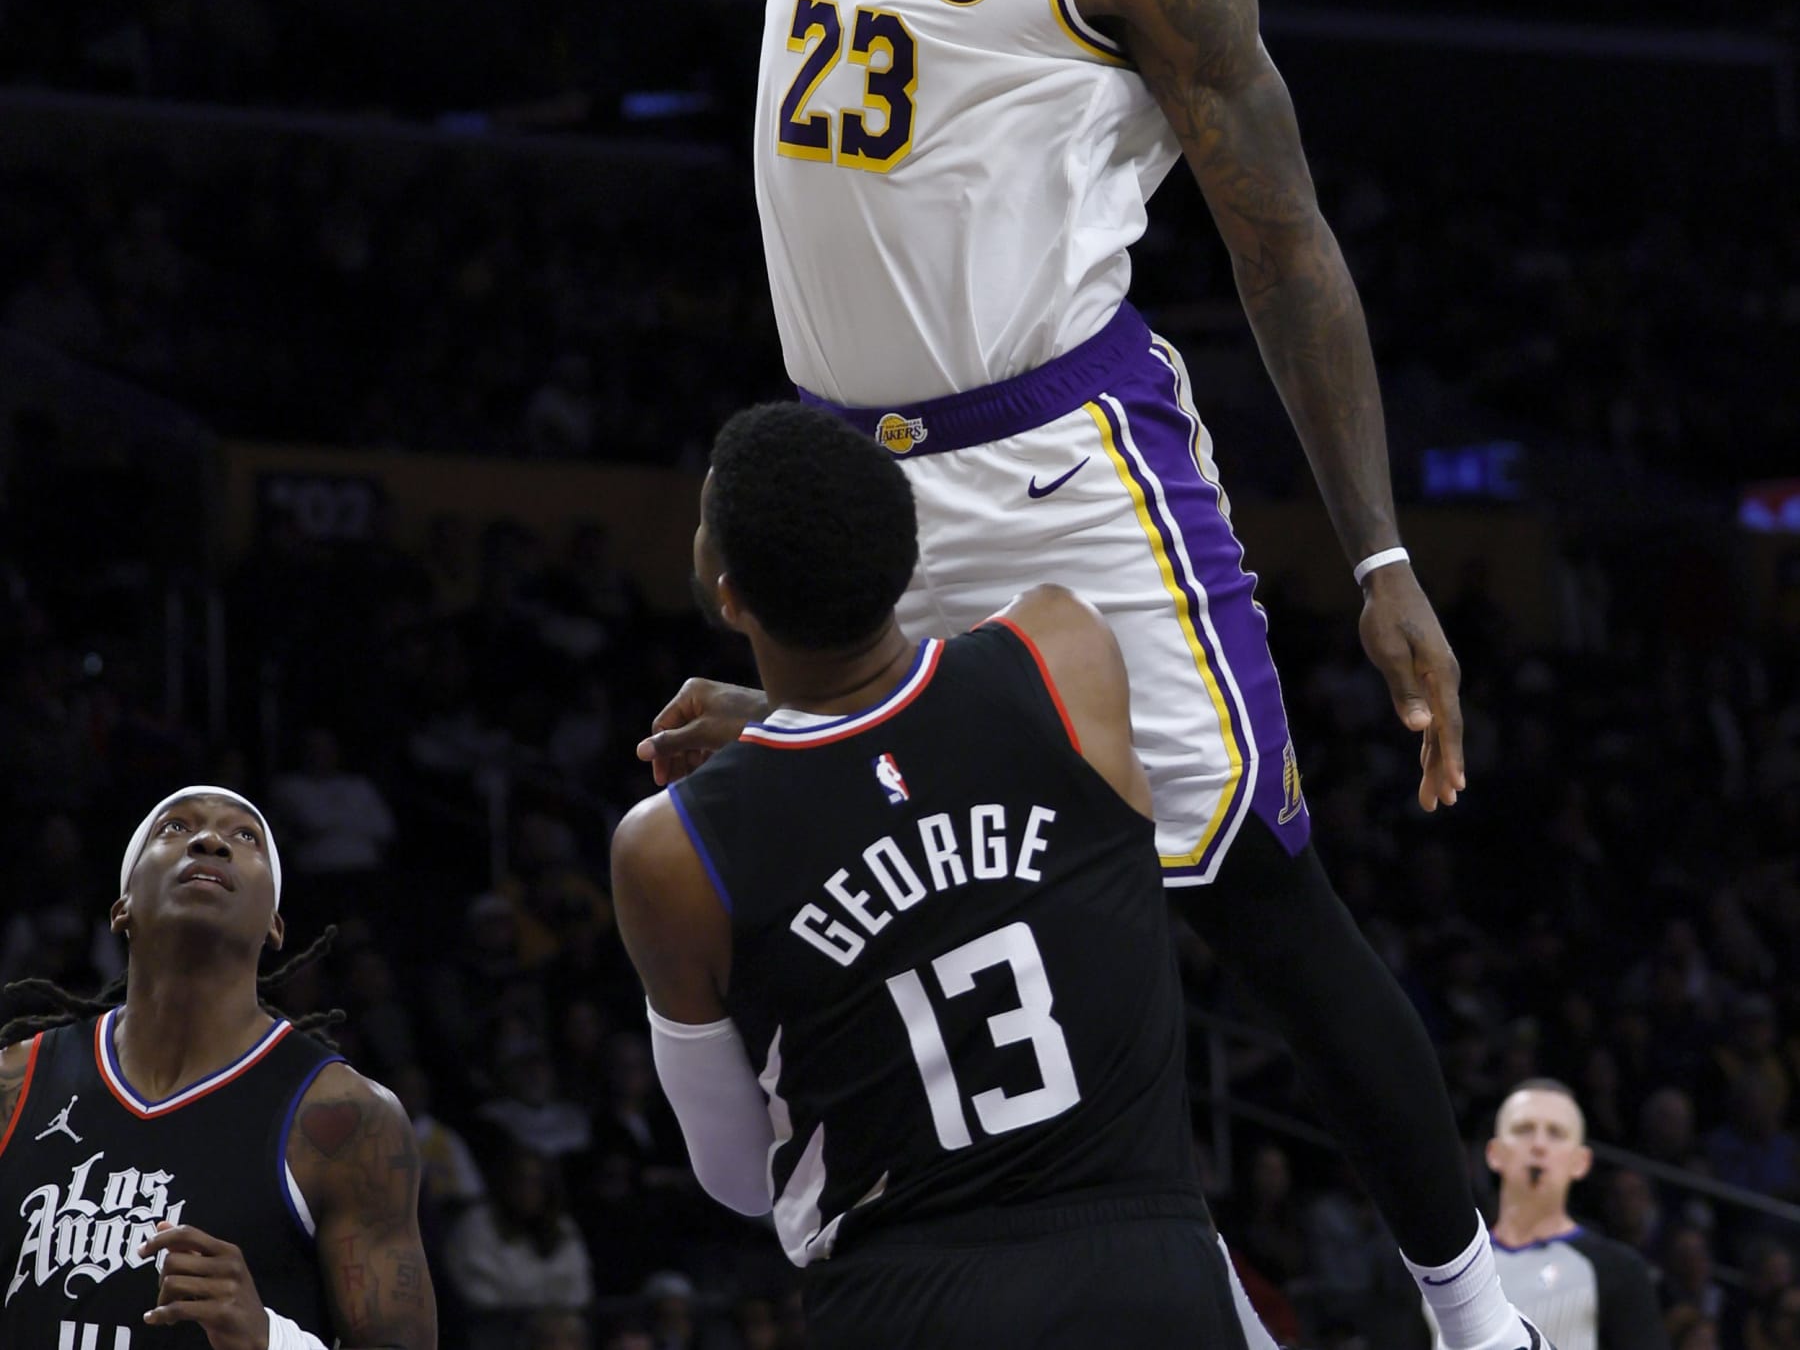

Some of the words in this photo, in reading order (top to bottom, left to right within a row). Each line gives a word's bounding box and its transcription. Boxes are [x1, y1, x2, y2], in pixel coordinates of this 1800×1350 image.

[789, 803, 1057, 968] GEORGE
[885, 921, 1081, 1151] 13
[56, 1151, 175, 1218] Los
